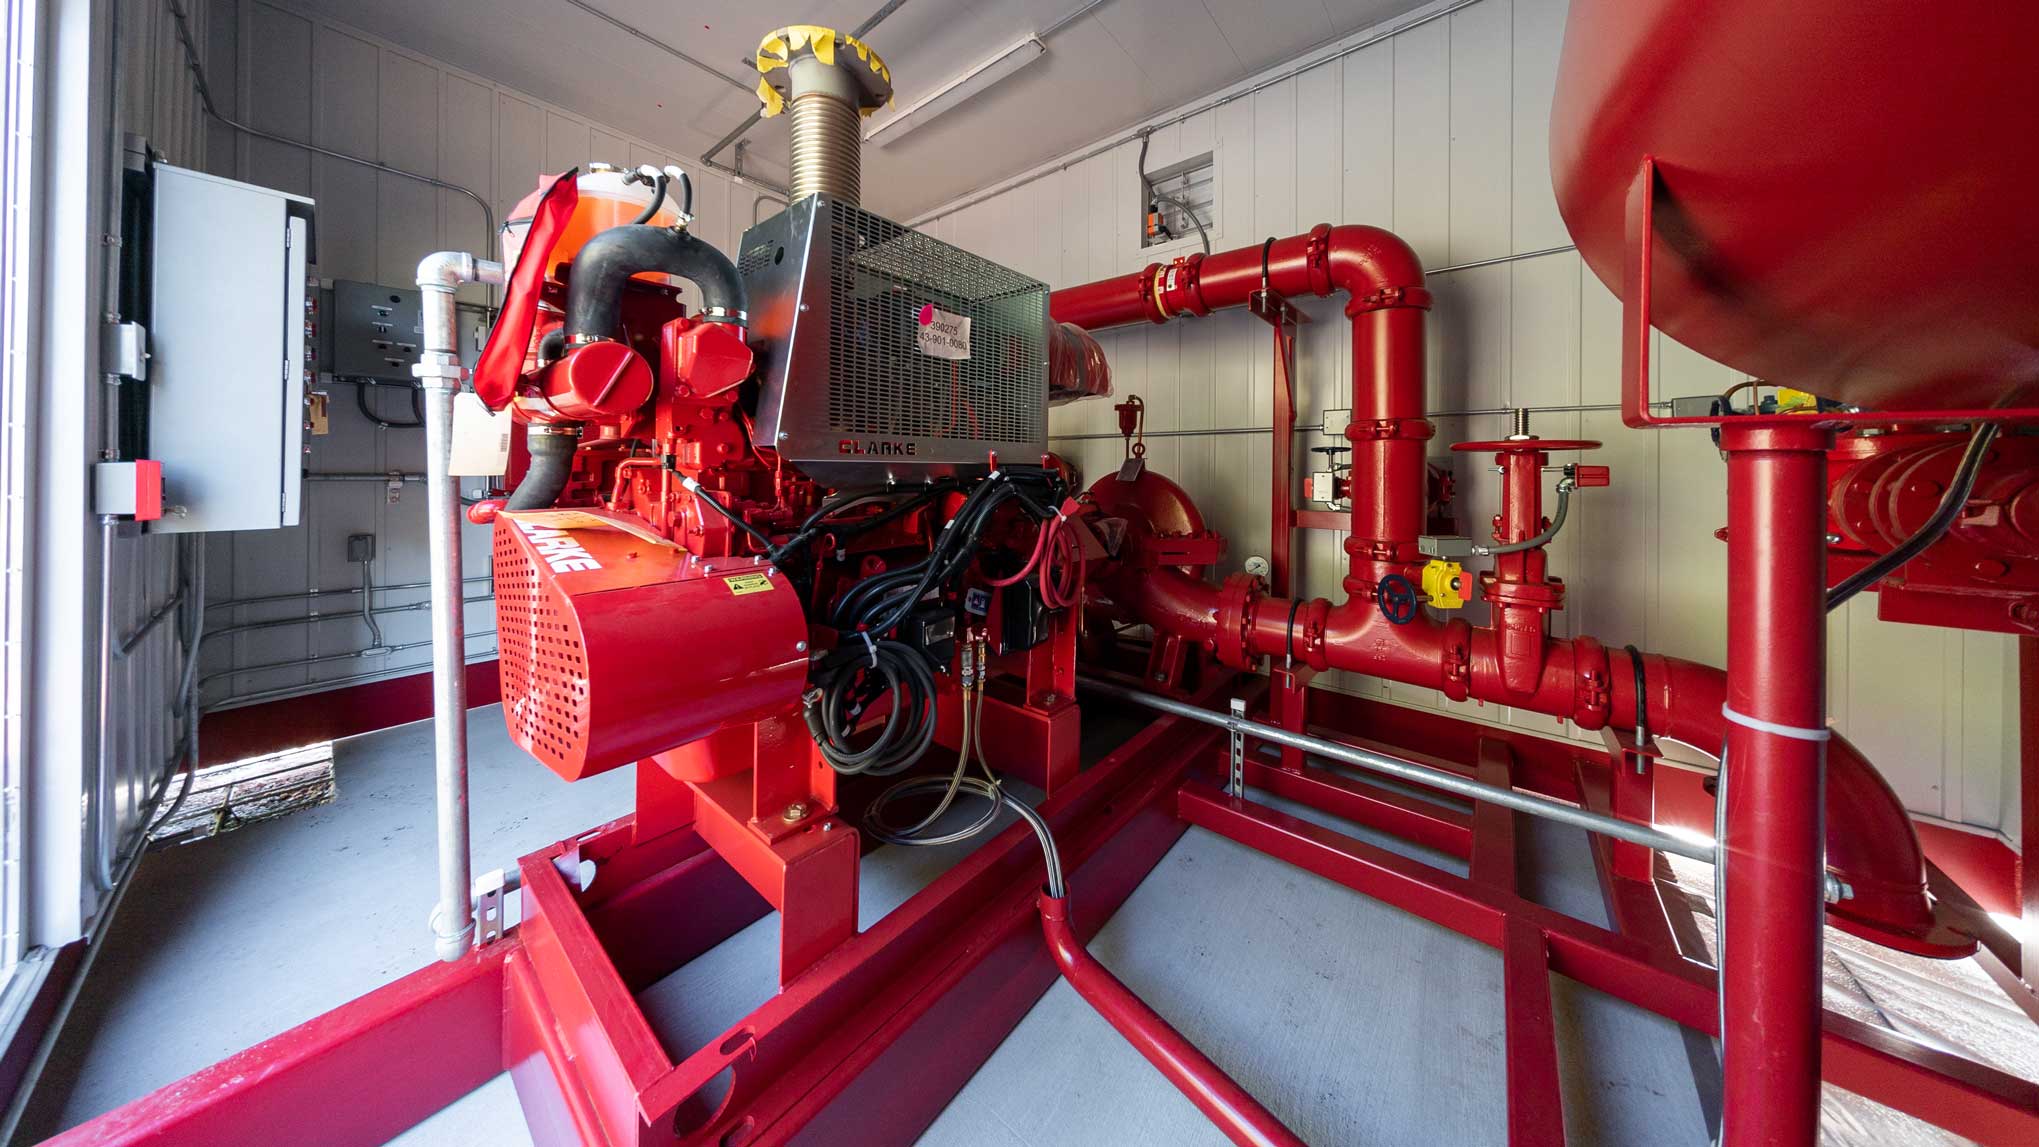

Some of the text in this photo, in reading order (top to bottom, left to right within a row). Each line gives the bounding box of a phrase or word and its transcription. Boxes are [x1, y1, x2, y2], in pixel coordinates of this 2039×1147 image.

[930, 321, 958, 336] 390275
[838, 439, 917, 456] CLARKE
[512, 518, 603, 574] LARKE
